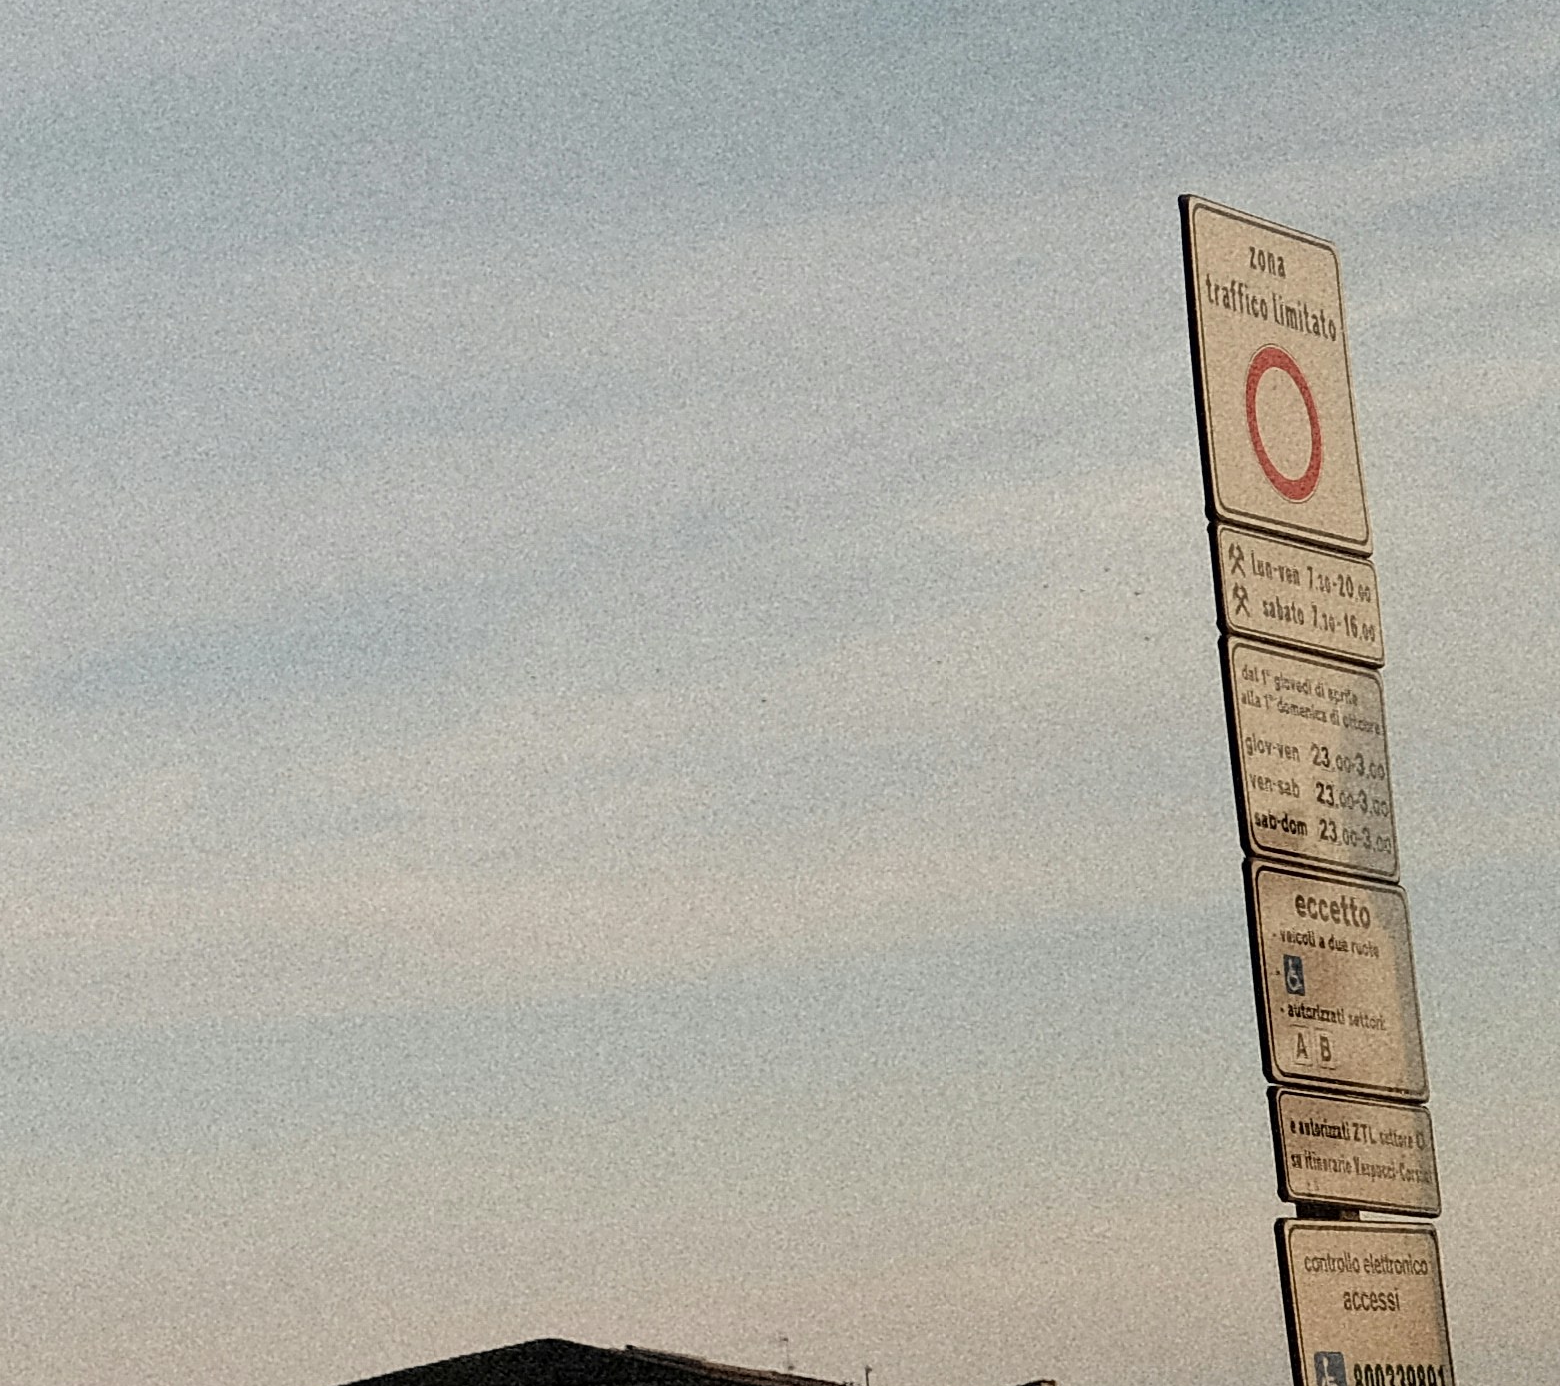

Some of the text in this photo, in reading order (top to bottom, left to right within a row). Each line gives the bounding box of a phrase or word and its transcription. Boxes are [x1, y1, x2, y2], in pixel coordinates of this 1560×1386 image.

[1248, 245, 1286, 279] zona
[1205, 273, 1337, 342] traffico limitato
[1262, 595, 1304, 626] sabato
[1241, 664, 1259, 682] dal
[1315, 681, 1325, 699] di
[1241, 690, 1261, 708] alla
[1330, 709, 1340, 726] di
[1294, 894, 1371, 929] eccetto
[1318, 936, 1326, 949] a
[1296, 1032, 1332, 1062] A B
[1352, 1122, 1378, 1145] ZTL
[1304, 1251, 1429, 1276] controllo elettronico
[1342, 1287, 1401, 1312] accessi
